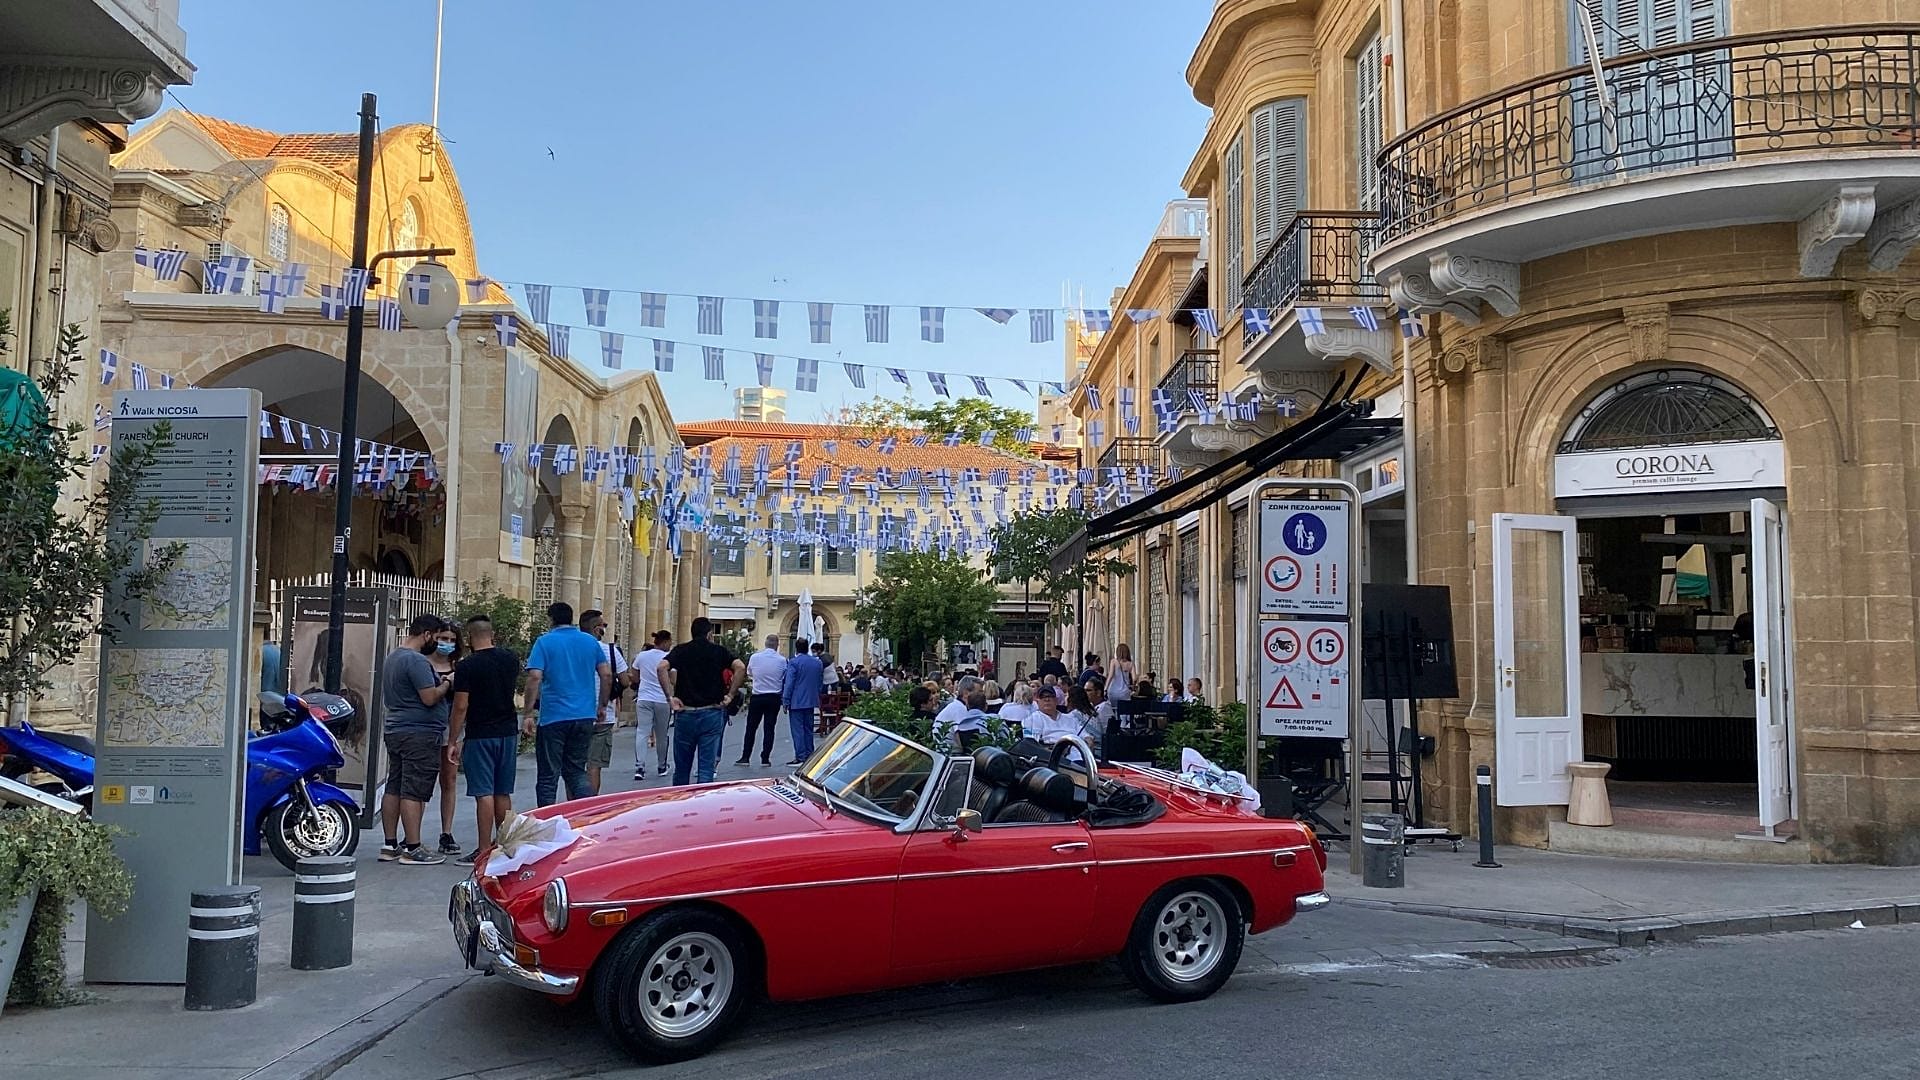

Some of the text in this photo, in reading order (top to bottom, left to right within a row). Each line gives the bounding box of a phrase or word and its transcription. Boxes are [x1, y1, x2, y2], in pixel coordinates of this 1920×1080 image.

[132, 406, 199, 415] Walk NICOSIA
[119, 432, 209, 441] FANERONI CHURCH
[1616, 454, 1715, 475] CORONA
[1676, 475, 1697, 483] lounge
[1315, 639, 1335, 653] 15
